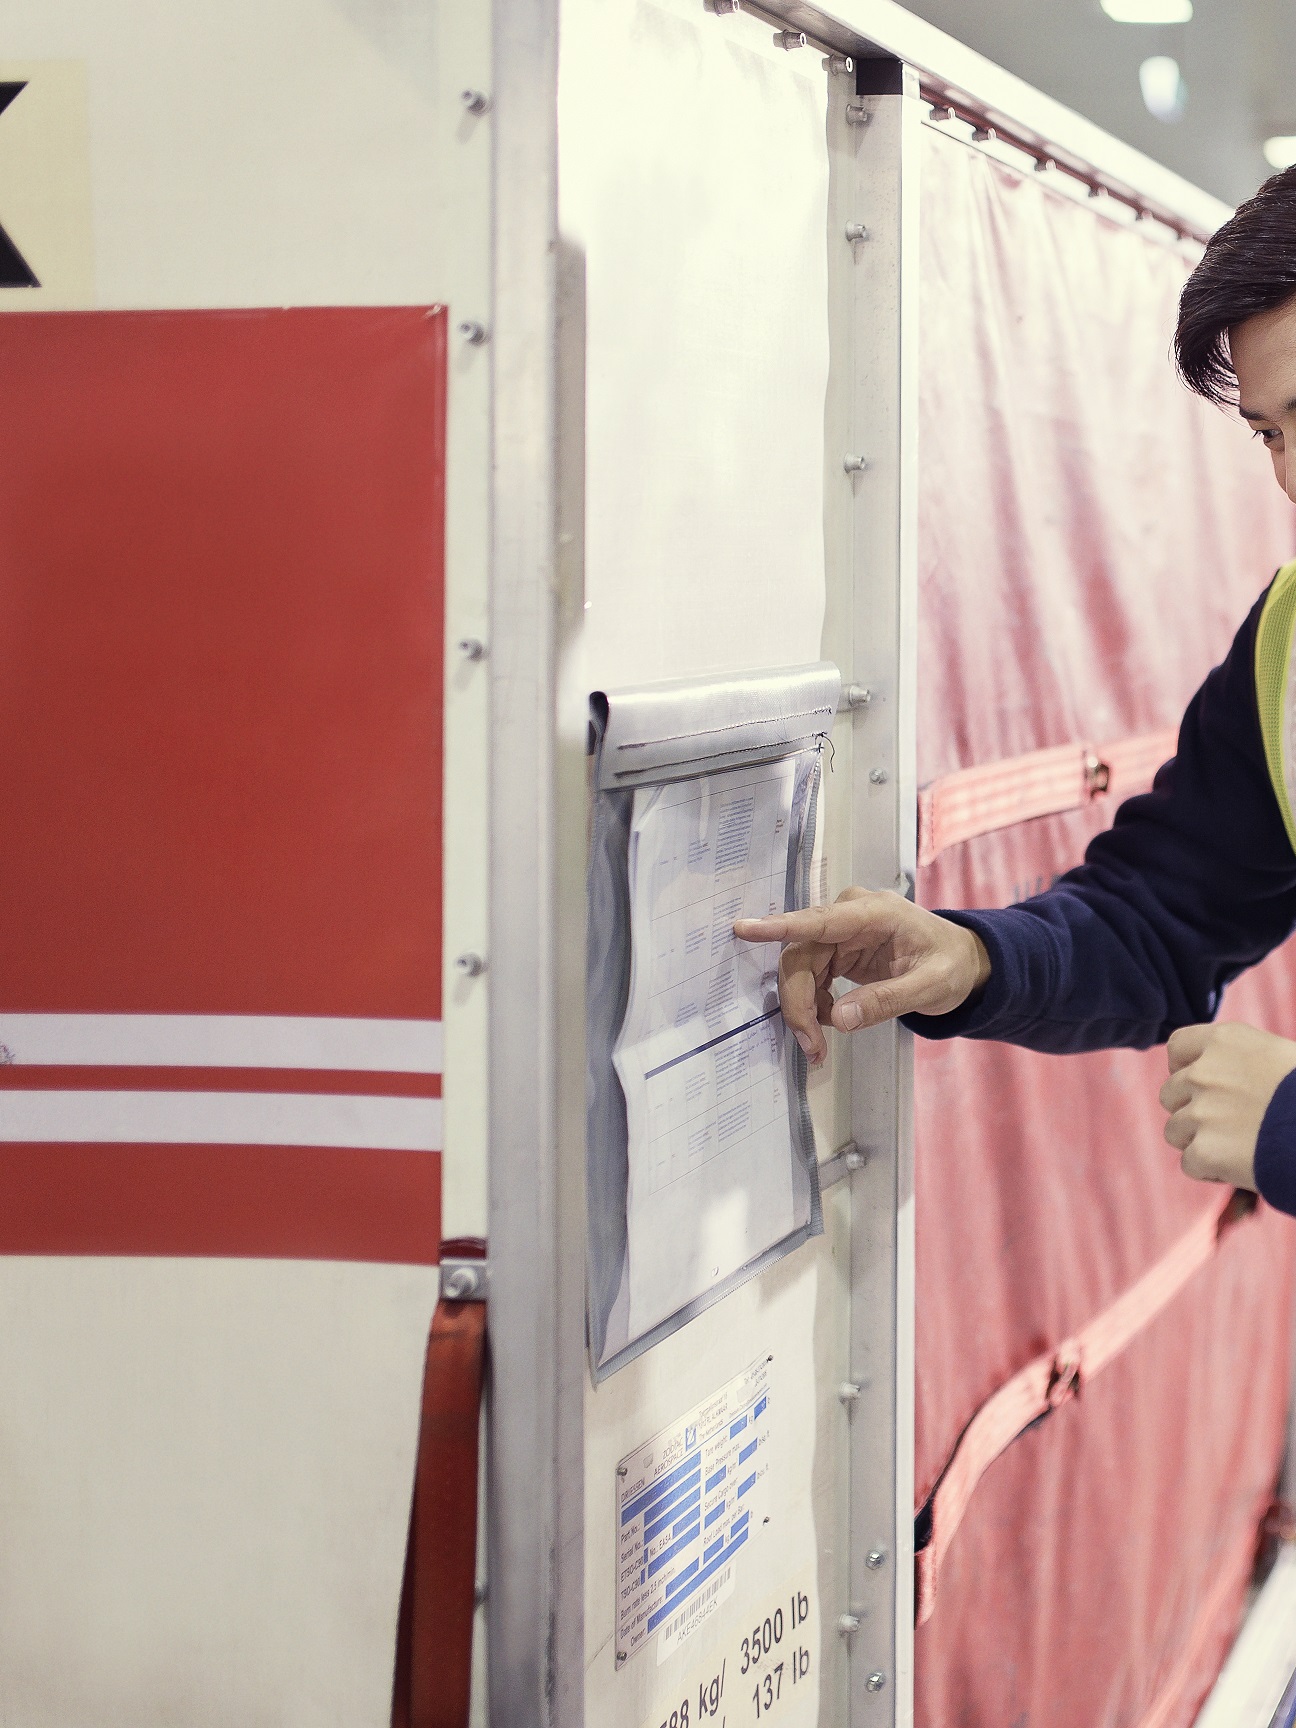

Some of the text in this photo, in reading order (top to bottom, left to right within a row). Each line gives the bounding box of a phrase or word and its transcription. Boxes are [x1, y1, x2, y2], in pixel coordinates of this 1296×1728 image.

[654, 1448, 683, 1476] AEROSPACE
[699, 1658, 726, 1721] kg/
[740, 1607, 784, 1675] 3500
[791, 1591, 809, 1630] lb
[752, 1646, 811, 1719] 137 lb
